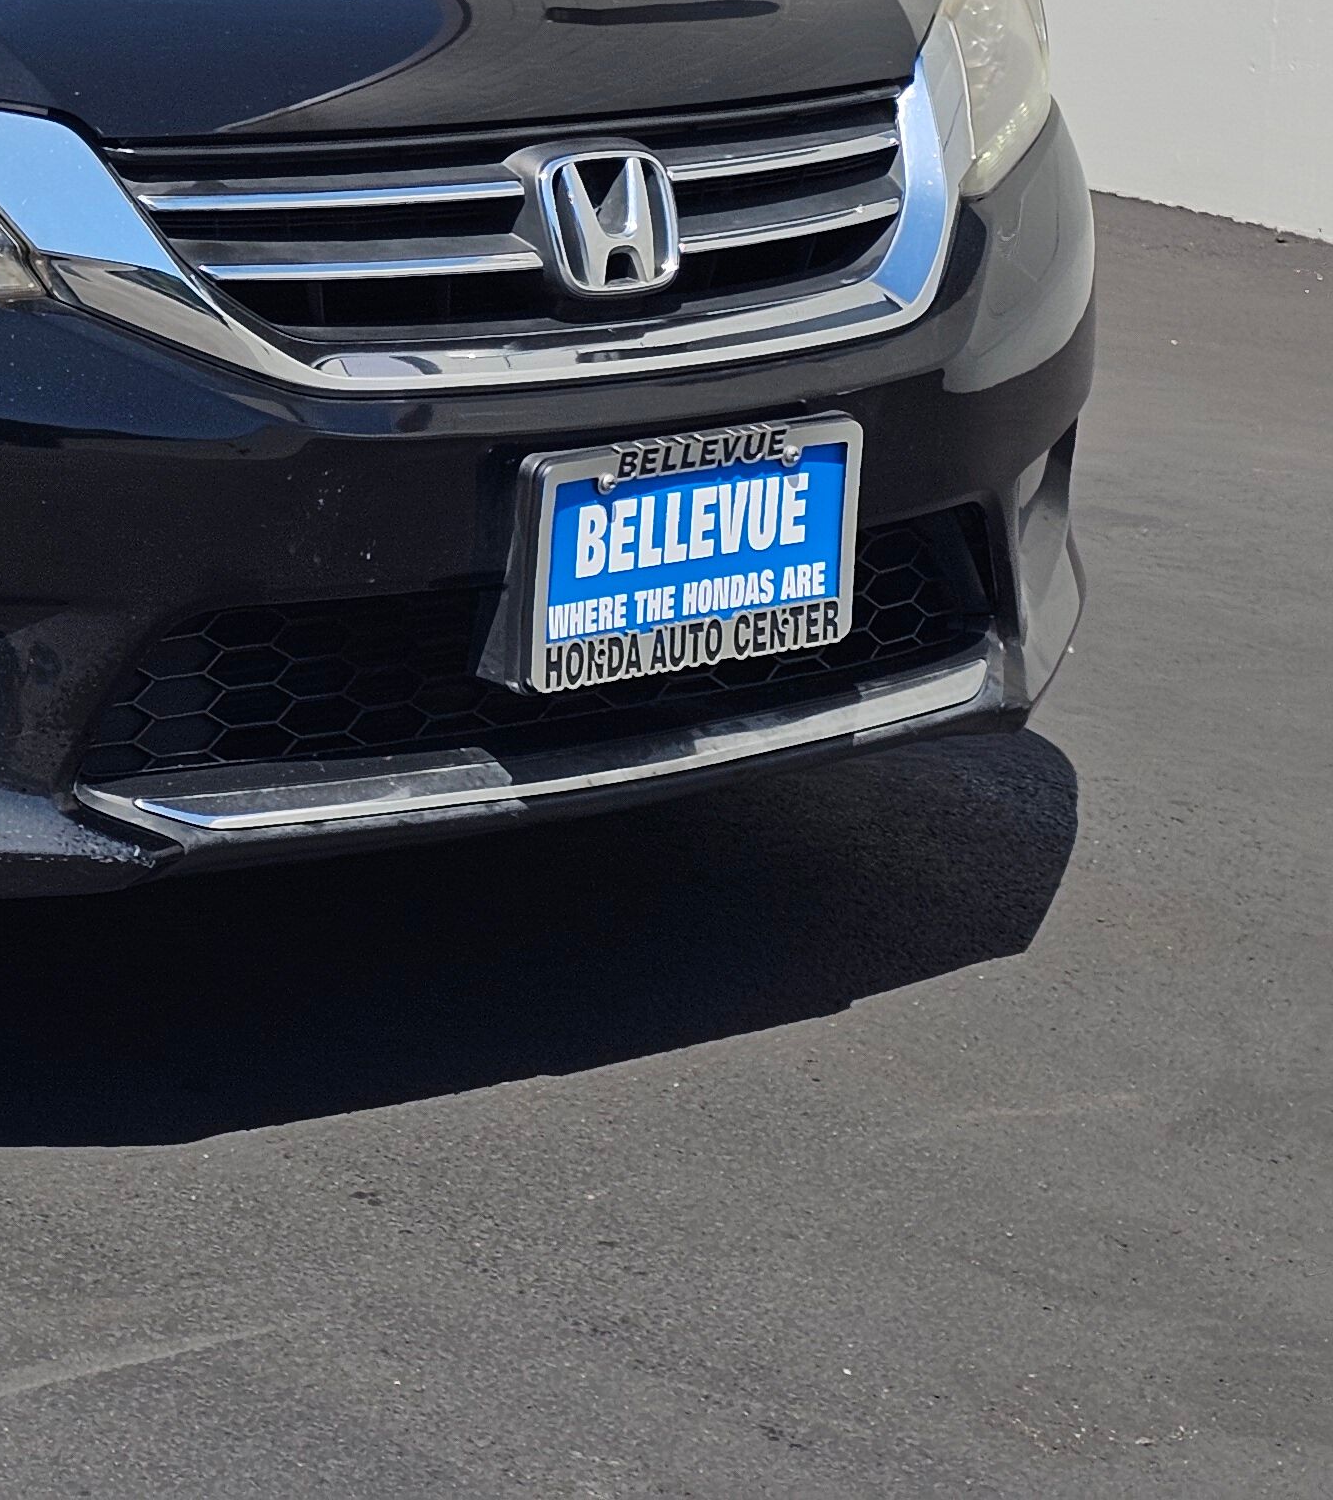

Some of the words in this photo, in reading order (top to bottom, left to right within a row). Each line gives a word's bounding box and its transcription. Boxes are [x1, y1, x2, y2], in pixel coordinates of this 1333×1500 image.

[617, 430, 788, 479] BELLEVUE
[575, 473, 809, 578] BELLEVUE
[548, 594, 626, 639] WHERE
[634, 584, 674, 623] THE
[683, 569, 774, 616] HONDAS
[781, 562, 825, 599] ARE
[546, 636, 642, 689] HONDA
[650, 619, 723, 671] AUTO
[734, 601, 839, 658] CENTER
